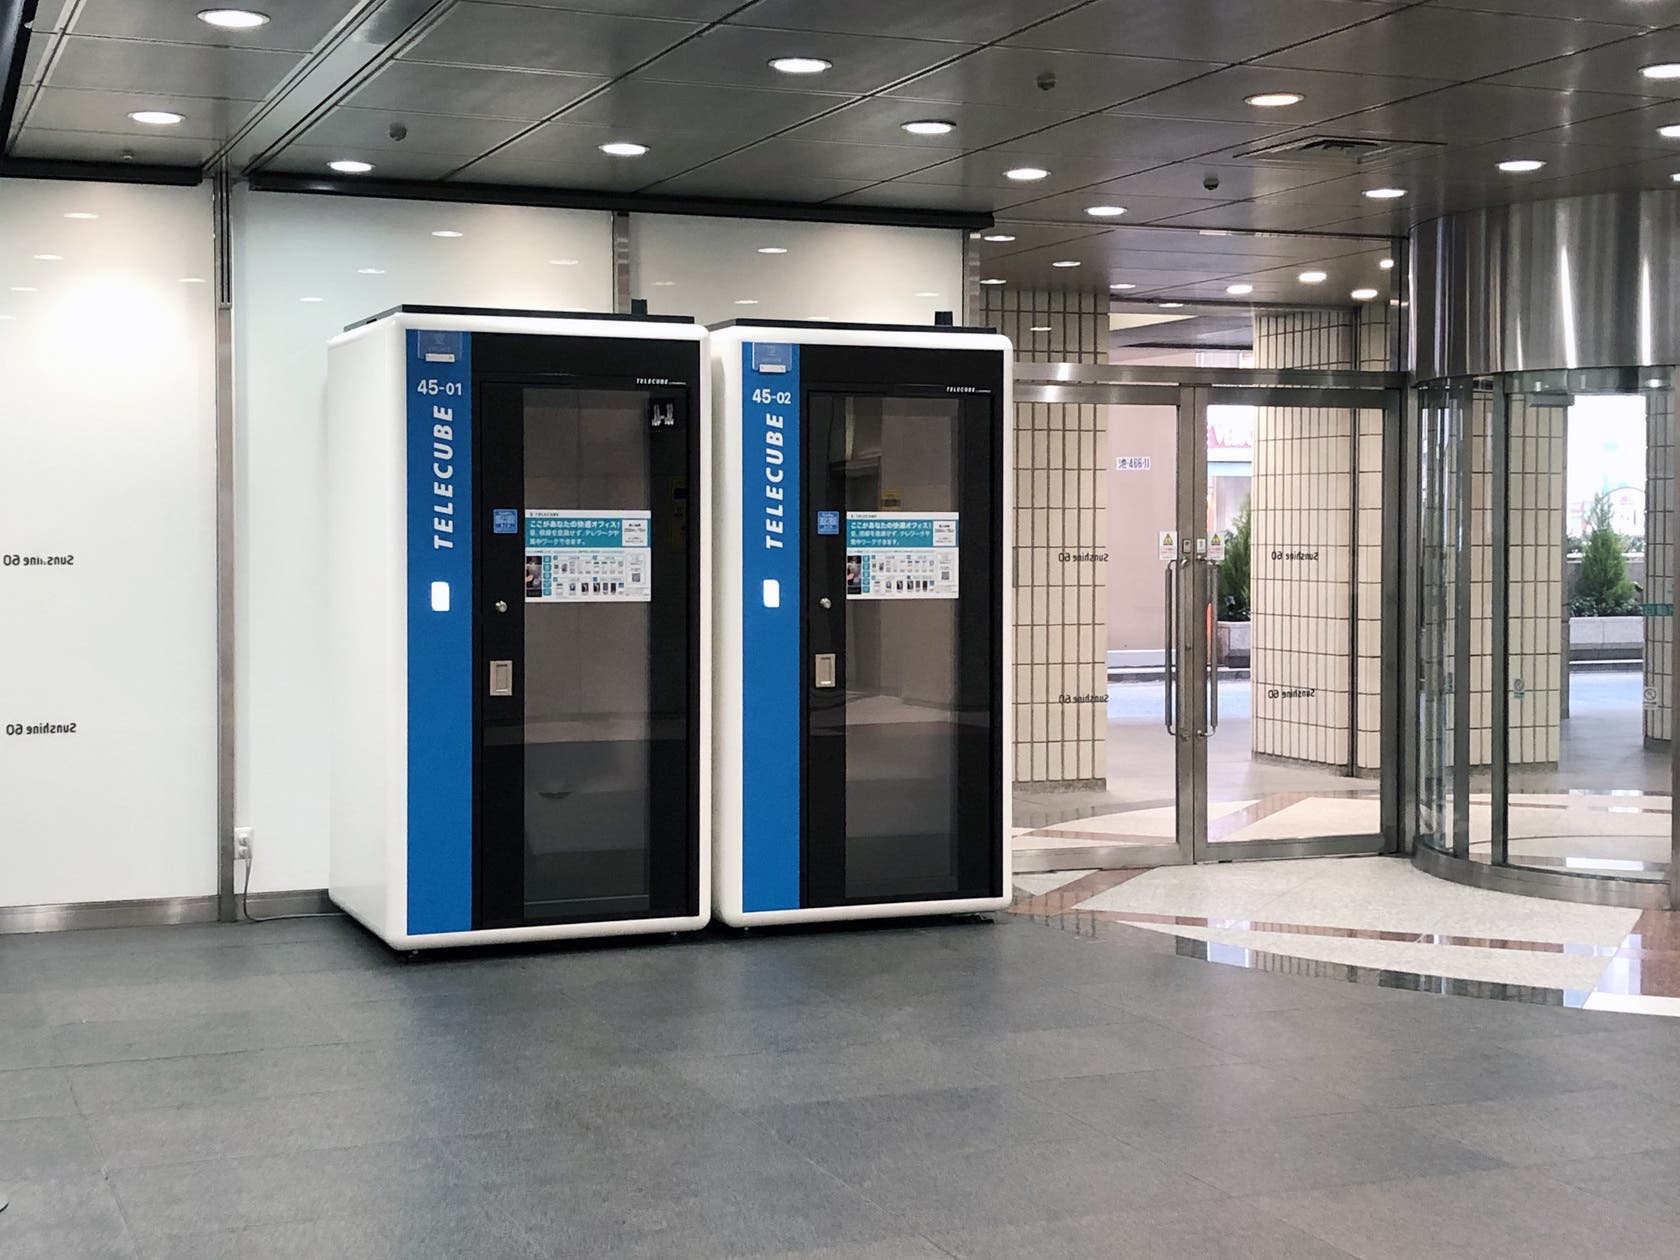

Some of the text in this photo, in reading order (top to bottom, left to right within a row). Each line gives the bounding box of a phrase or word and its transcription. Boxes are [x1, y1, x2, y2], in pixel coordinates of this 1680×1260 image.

[417, 379, 462, 396] 45-01
[752, 389, 792, 405] 45-02
[433, 405, 453, 549] TELECUBE
[766, 413, 784, 549] TELECUBE
